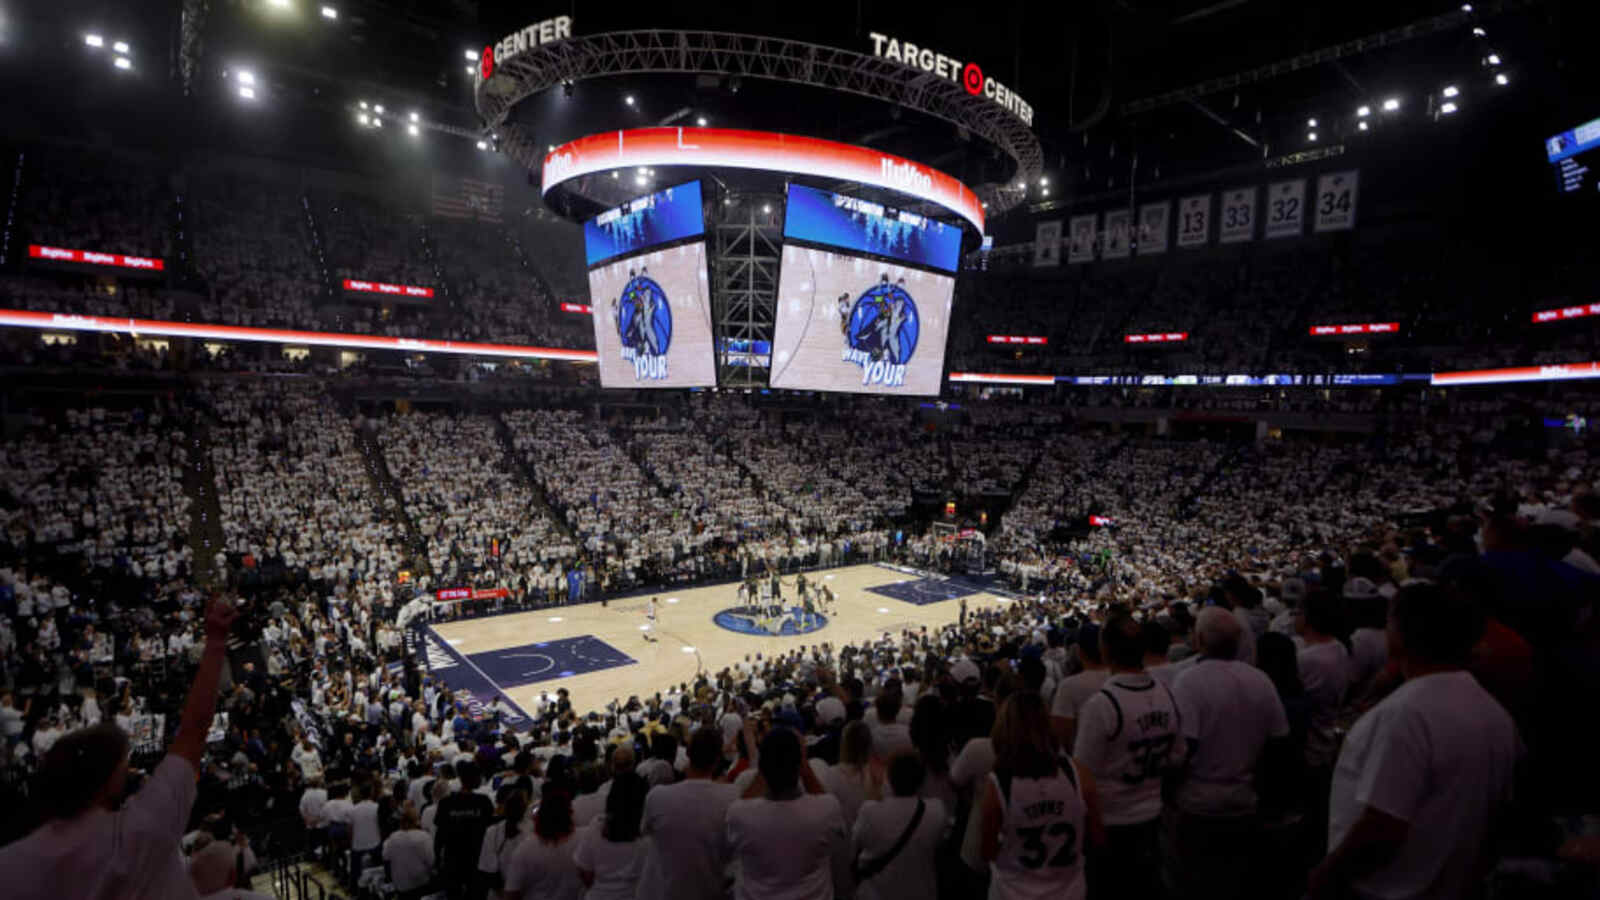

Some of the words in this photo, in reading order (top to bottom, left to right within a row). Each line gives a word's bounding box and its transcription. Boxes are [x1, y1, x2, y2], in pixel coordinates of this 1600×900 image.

[494, 15, 571, 65] CENTER
[870, 32, 962, 83] TARGET
[984, 77, 1034, 128] CENTER
[1225, 204, 1250, 228] 33
[1272, 197, 1299, 223] 32
[1320, 189, 1351, 215] 34
[1183, 211, 1204, 233] 13
[634, 352, 668, 381] YOUR
[862, 355, 906, 387] YOUR
[1015, 821, 1077, 870] 32
